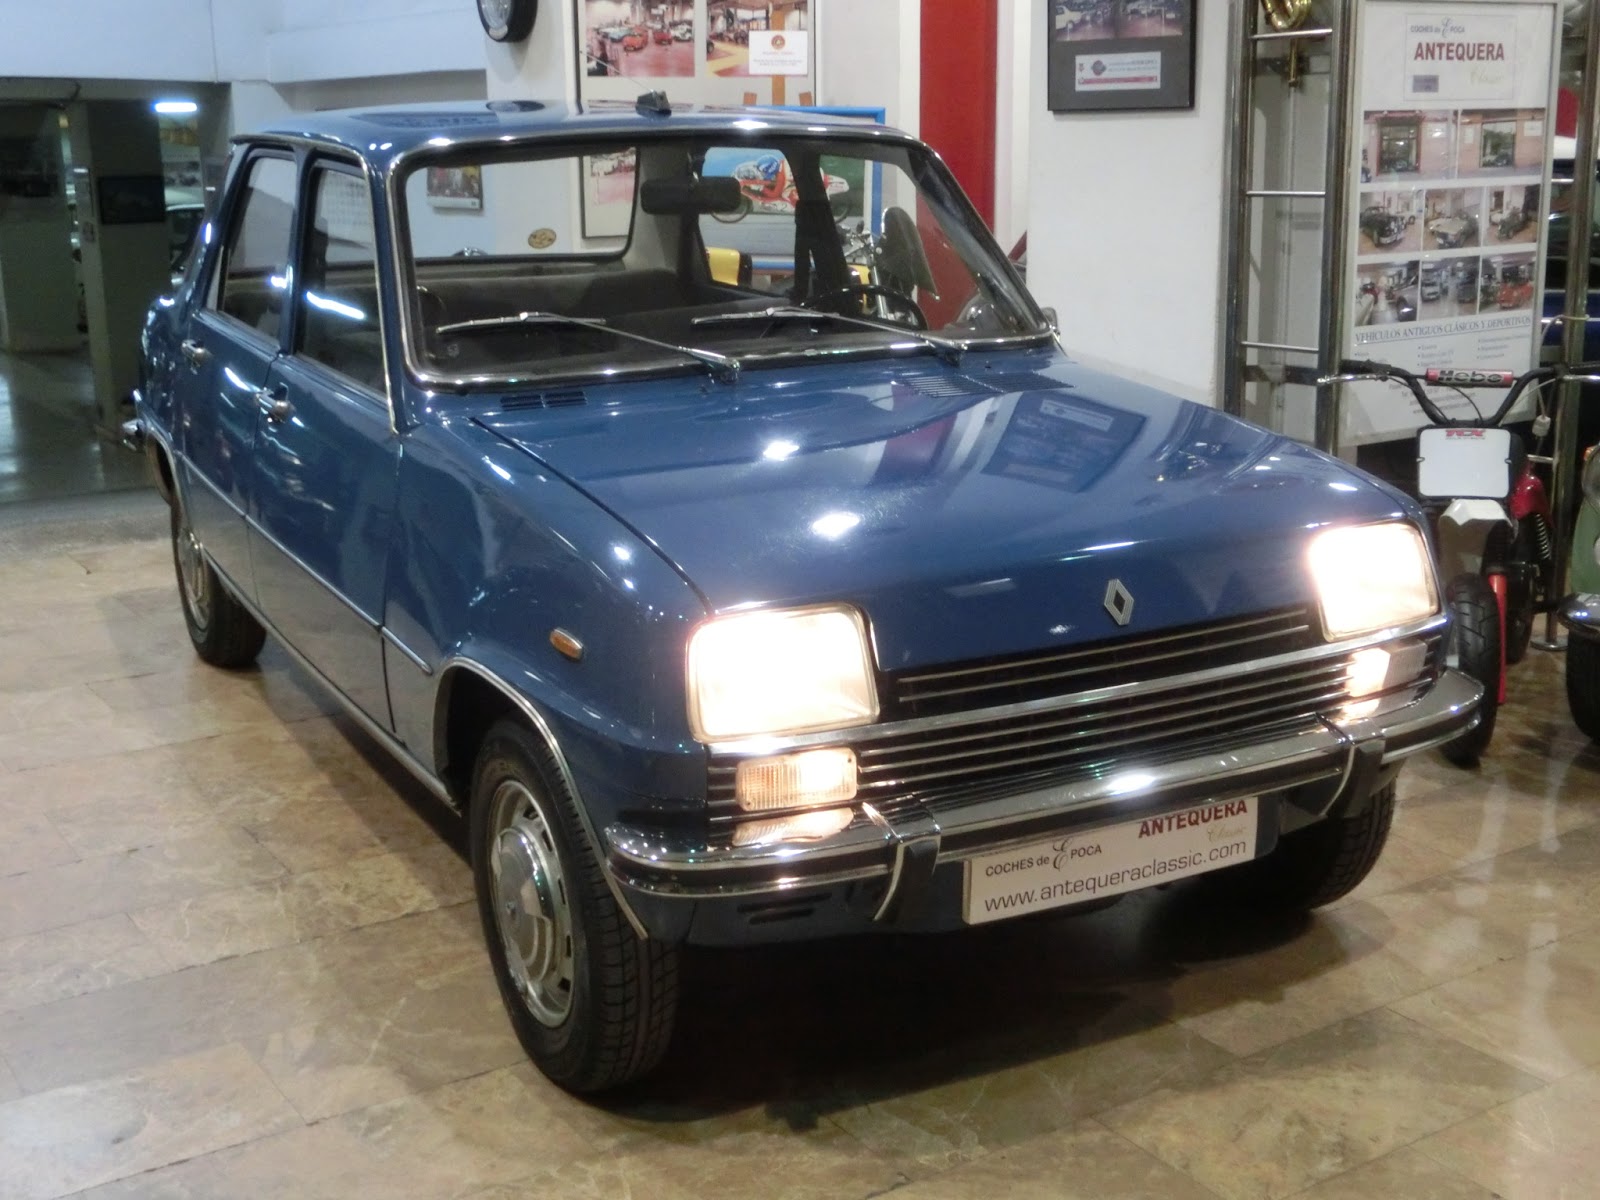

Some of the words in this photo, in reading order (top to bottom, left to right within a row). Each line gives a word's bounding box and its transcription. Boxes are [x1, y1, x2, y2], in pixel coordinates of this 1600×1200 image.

[1410, 25, 1433, 33] COCHES
[1414, 42, 1505, 61] ANTEQUERA
[1402, 324, 1445, 338] ANTIGUOS
[1480, 319, 1487, 329] Y
[1487, 315, 1531, 328] DEPORTIVOS
[1138, 799, 1248, 839] ANTEQUERA
[984, 839, 1247, 912] www.antequeraclassic.com
[985, 855, 1034, 878] COCHES
[1036, 853, 1050, 866] de
